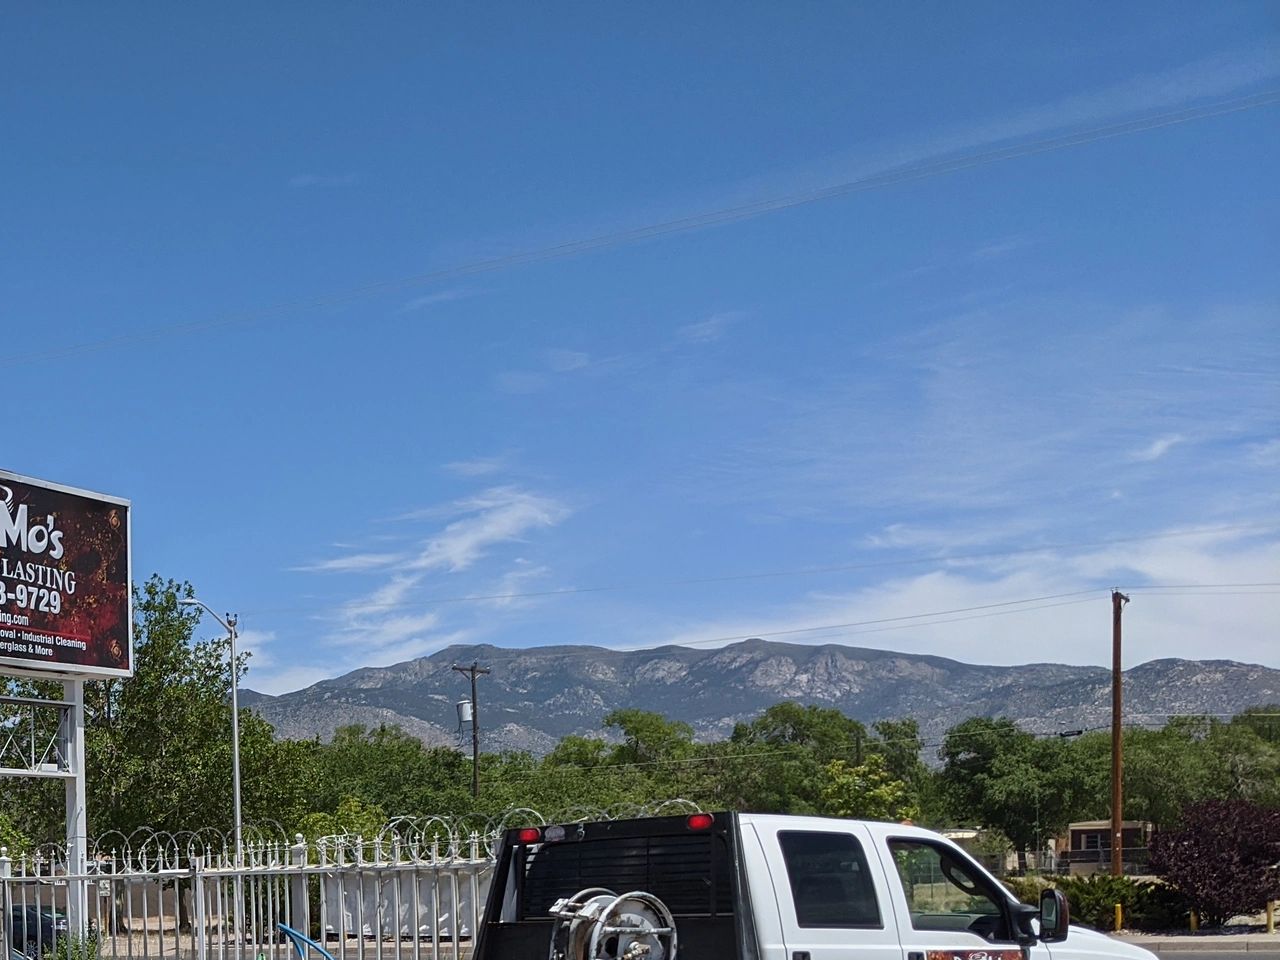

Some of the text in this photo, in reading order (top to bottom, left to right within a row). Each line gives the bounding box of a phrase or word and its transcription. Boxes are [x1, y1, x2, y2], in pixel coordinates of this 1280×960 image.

[22, 631, 54, 645] Industrial
[55, 636, 87, 651] Cleaning
[28, 645, 34, 653] &
[34, 645, 53, 656] More
